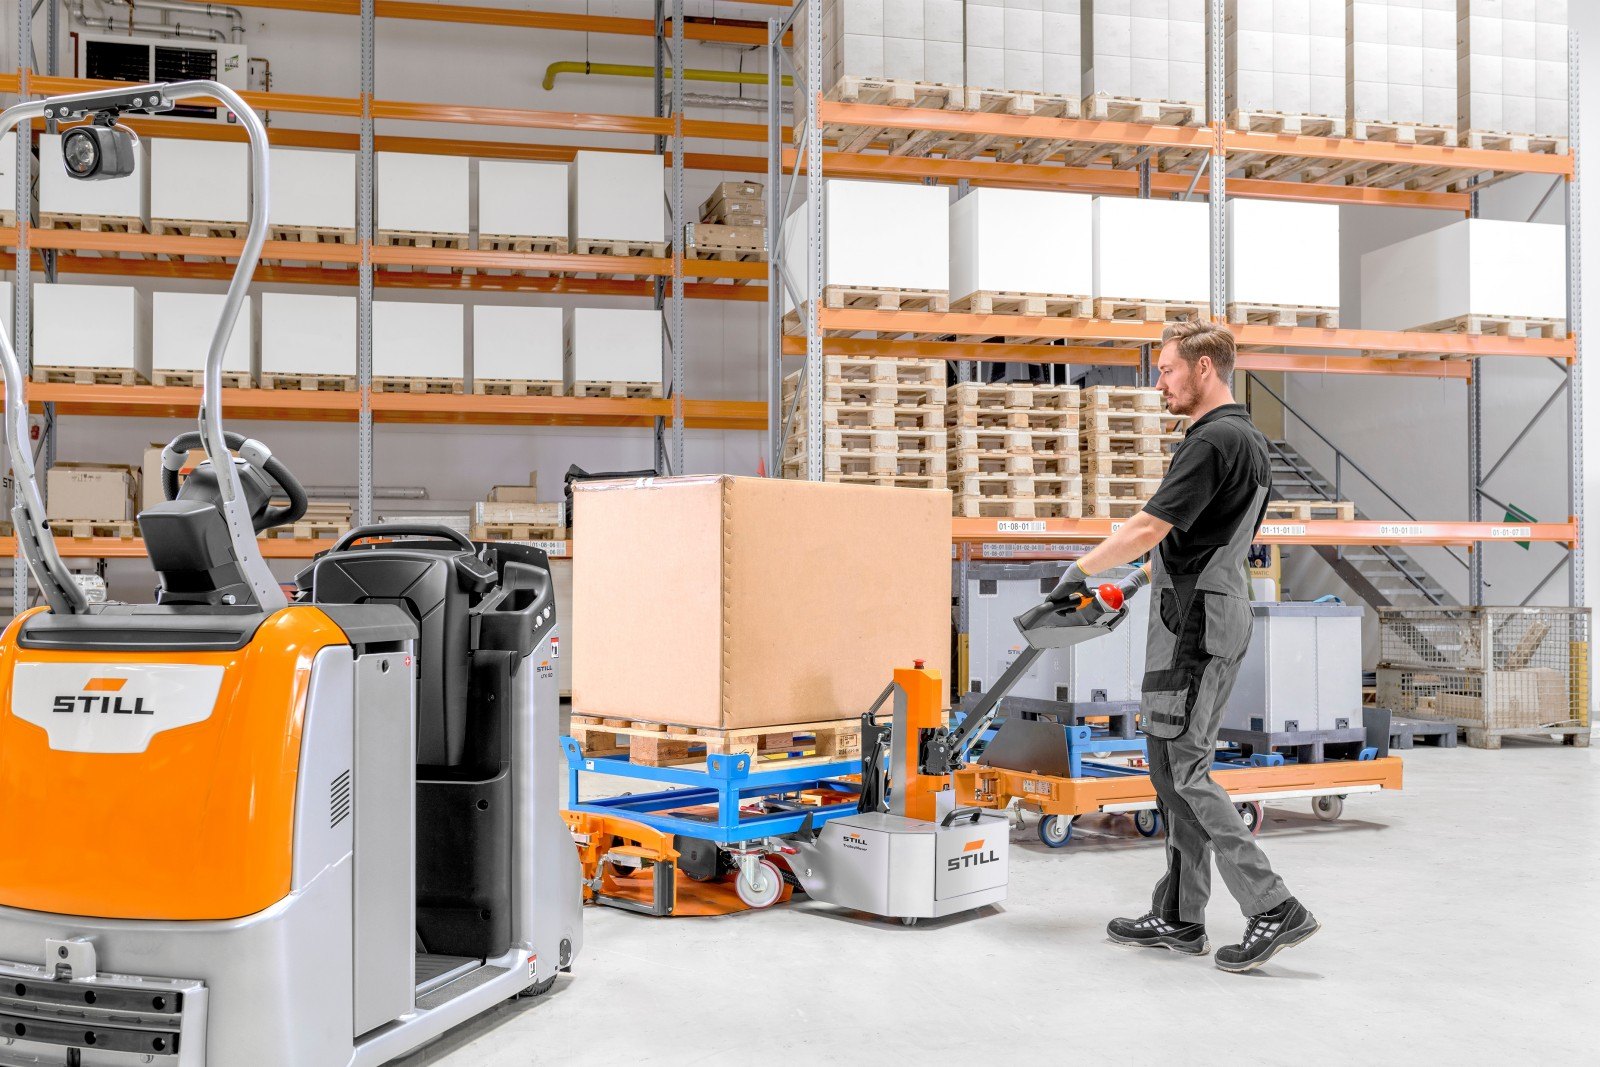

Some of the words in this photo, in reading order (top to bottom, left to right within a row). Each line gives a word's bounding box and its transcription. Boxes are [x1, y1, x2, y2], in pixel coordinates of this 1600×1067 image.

[3, 477, 14, 490] STI
[998, 522, 1029, 531] 01-08-01
[1262, 526, 1290, 534] 01-11-01
[1380, 526, 1408, 534] 01-10-01
[52, 695, 154, 715] STILL
[843, 836, 868, 846] STILL
[947, 850, 1000, 872] STILL
